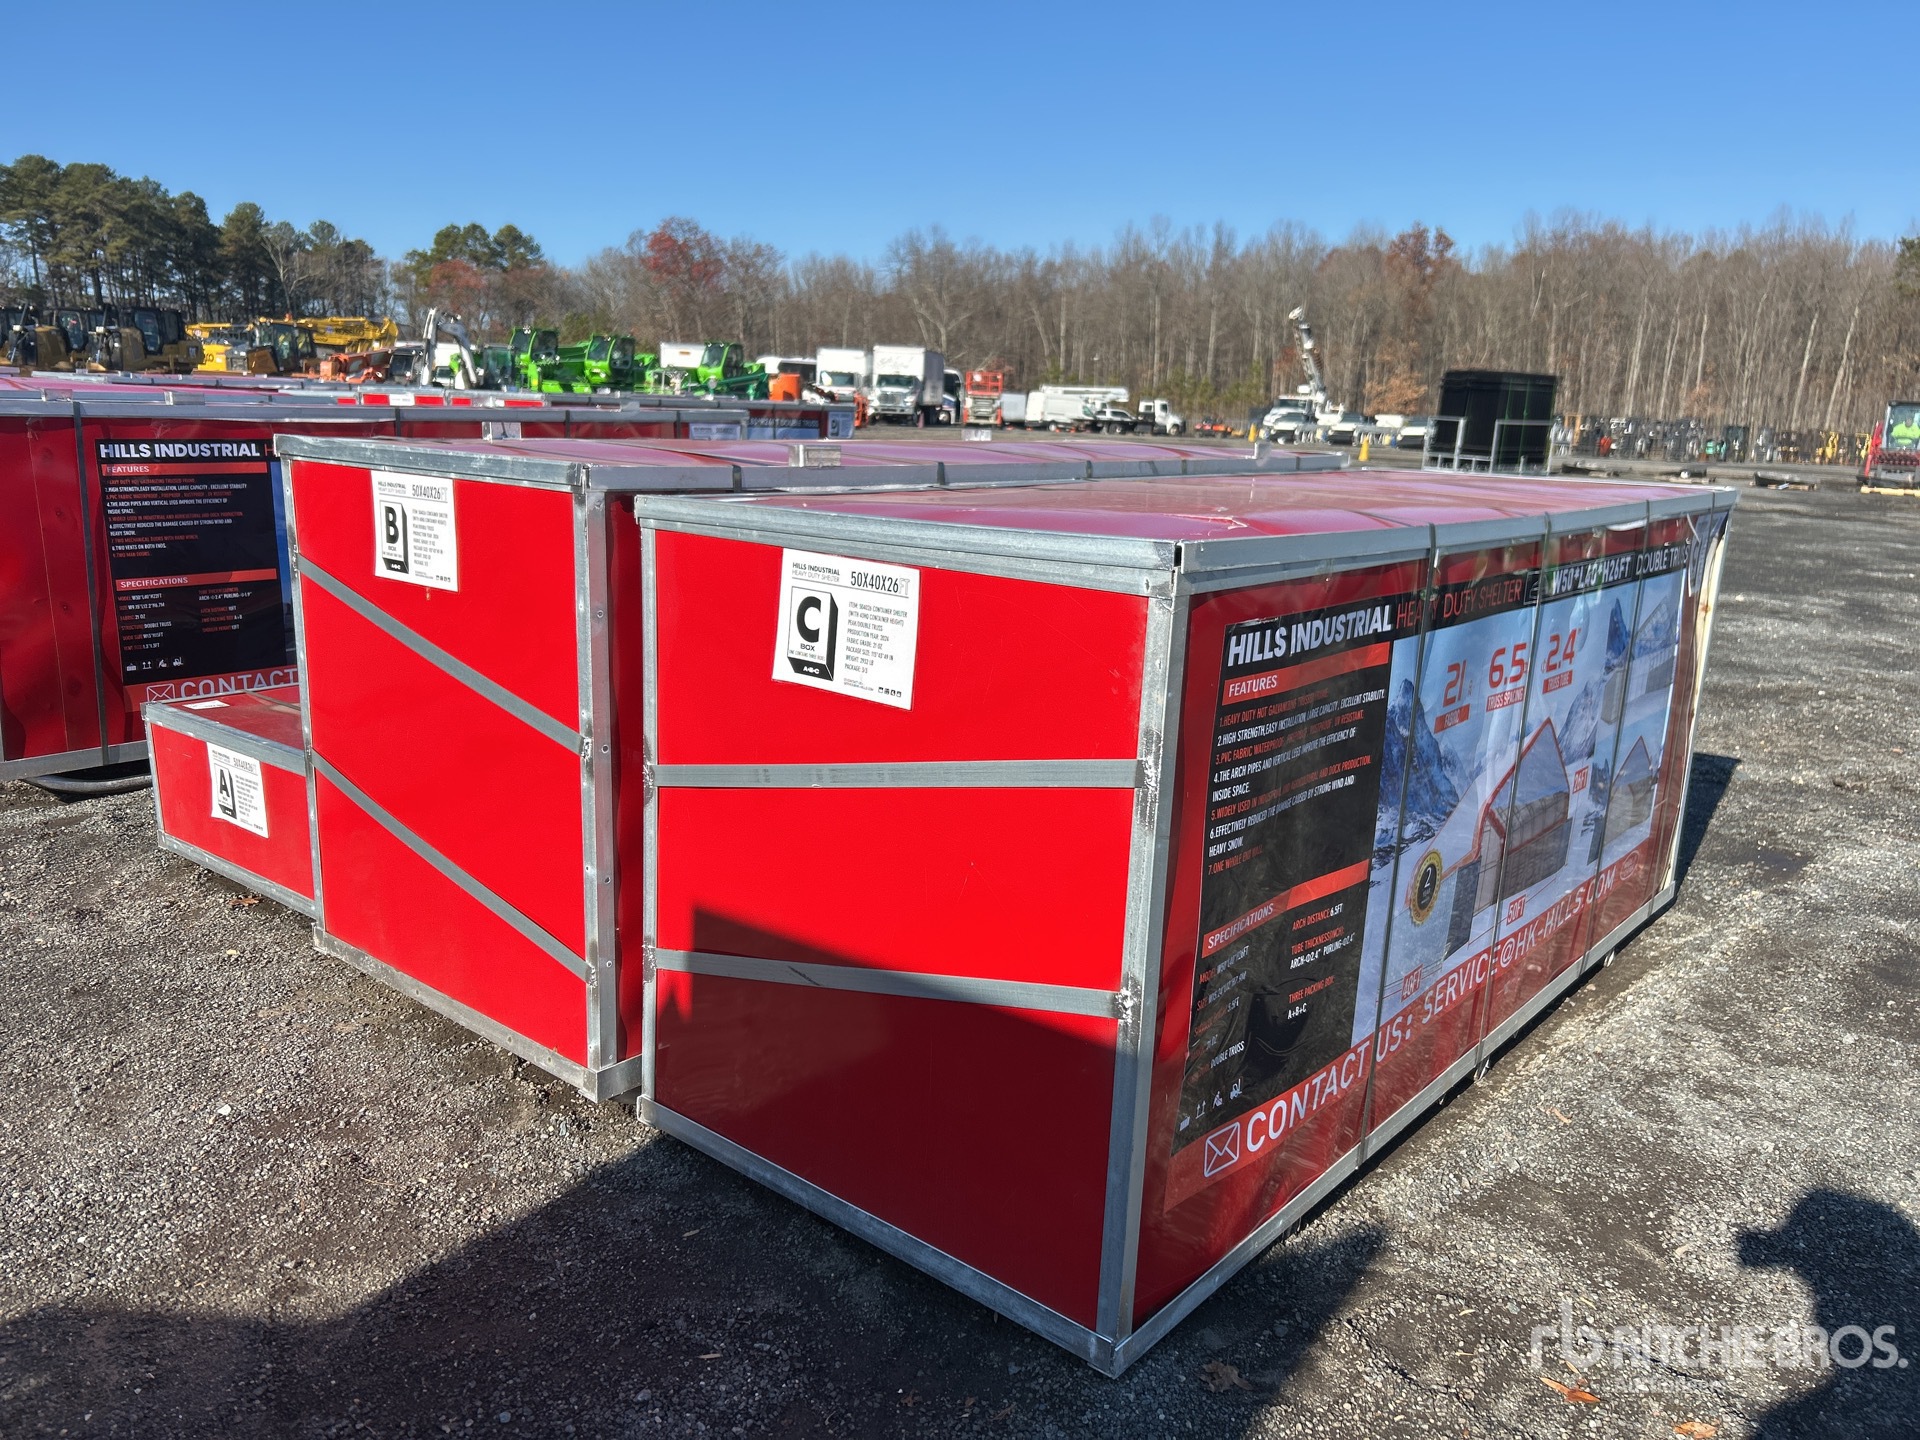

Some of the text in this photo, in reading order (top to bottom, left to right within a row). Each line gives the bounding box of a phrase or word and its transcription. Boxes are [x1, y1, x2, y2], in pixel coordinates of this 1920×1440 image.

[100, 444, 151, 458] HILLS
[155, 442, 260, 458] INDUSTRIAL
[107, 465, 150, 474] FEATURES
[384, 506, 400, 544] B
[792, 562, 840, 576] HILLS INDUSTRIAL
[822, 574, 840, 582] SHELTER
[120, 577, 188, 588] SPECIFICATIONS
[796, 596, 822, 643] C
[1228, 626, 1287, 667] HILLS
[1290, 604, 1392, 655] INDUSTRIAL
[1396, 597, 1440, 630] HEAY
[1444, 588, 1478, 618] DUTY
[1478, 580, 1522, 608] SHELTER
[1636, 549, 1668, 576] DOUBLE
[800, 643, 815, 652] BOX
[1488, 642, 1526, 689] 6.5
[180, 668, 299, 698] CONTACT
[1228, 674, 1278, 698] FEATURES
[1443, 660, 1467, 708] 21
[1548, 672, 1570, 692] TRUSS TUBE
[1488, 688, 1524, 710] TRUSS SPACING
[1217, 732, 1237, 746] 2.HIGH
[1237, 720, 1278, 742] STRENGTH,EASY
[1319, 701, 1338, 716] CAPACITY
[1340, 693, 1362, 710] EXCELLENT
[1220, 712, 1240, 728] 1.HEAVY
[1242, 709, 1256, 723] DUTY
[1256, 706, 1268, 719] HOT
[1214, 770, 1231, 784] 4.THE
[1230, 767, 1246, 780] ARCH
[1247, 761, 1262, 776] PIPES
[1262, 756, 1272, 770] AND
[1272, 750, 1291, 767] VERTICAL
[1326, 728, 1349, 745] EFFICIENCY
[1349, 726, 1356, 738] OF
[1215, 751, 1232, 766] 3.PVC
[1232, 746, 1253, 760] FABRIC
[220, 769, 230, 798] A
[1212, 782, 1250, 802] INSIDE SPACE.
[1574, 768, 1588, 793] 26FT
[1210, 818, 1248, 840] 6.EFFECTIVELY
[1247, 810, 1267, 827] REDUCED
[1308, 787, 1314, 800] BY
[1314, 781, 1332, 797] STRONG
[1332, 777, 1344, 790] WIND
[1344, 774, 1355, 787] AND
[1211, 802, 1237, 821] 5.WIDELY
[1237, 799, 1251, 813] USED
[1251, 796, 1258, 808] IN
[1209, 836, 1244, 858] HEAVY SNOW.
[1208, 860, 1225, 876] 7.ONE
[1424, 866, 1432, 888] 2
[1508, 896, 1526, 924] 50FT
[1208, 902, 1274, 950] SPECIFICATIONS
[1292, 919, 1306, 931] ARCH
[1291, 942, 1304, 956] TUBE
[1289, 989, 1304, 1004] THREE
[1304, 980, 1324, 998] PACKING
[1404, 967, 1422, 998] 40FT
[1247, 1042, 1370, 1152] CONTACT
[1376, 1012, 1412, 1062] US:
[1422, 866, 1616, 1024] SERVICE@HK-HILLS.COM
[1288, 1002, 1308, 1020] A+B+C
[1228, 1040, 1245, 1058] TRUSS
